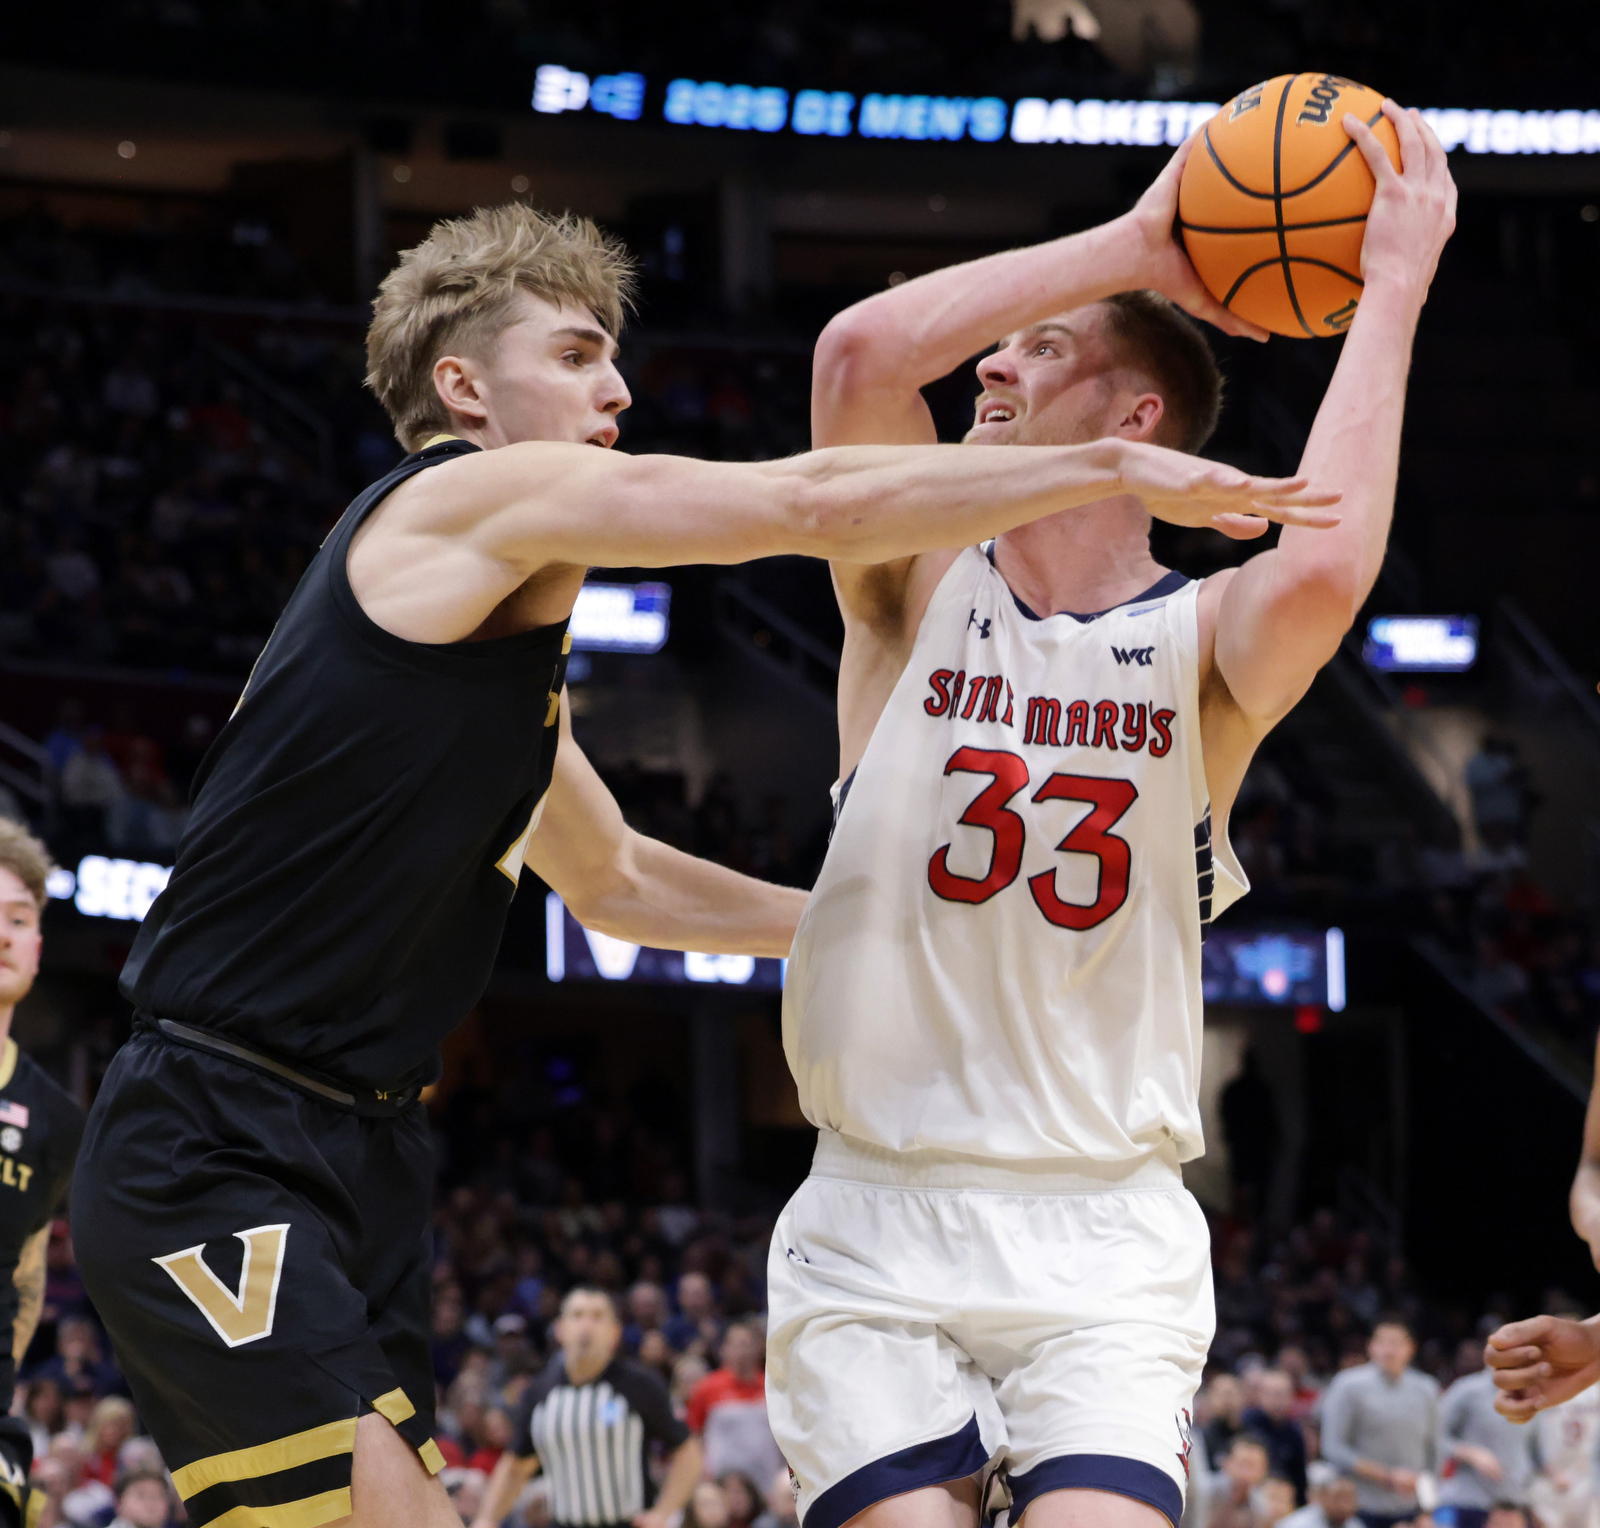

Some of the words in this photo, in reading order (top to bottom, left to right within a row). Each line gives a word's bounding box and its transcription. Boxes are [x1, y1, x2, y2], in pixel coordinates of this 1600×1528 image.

[857, 93, 1008, 142] MEN'S
[1023, 696, 1176, 758] MARY'S
[928, 745, 1139, 931] 33
[76, 854, 174, 922] SEC
[0, 1153, 34, 1192] LT
[151, 1223, 291, 1348] V
